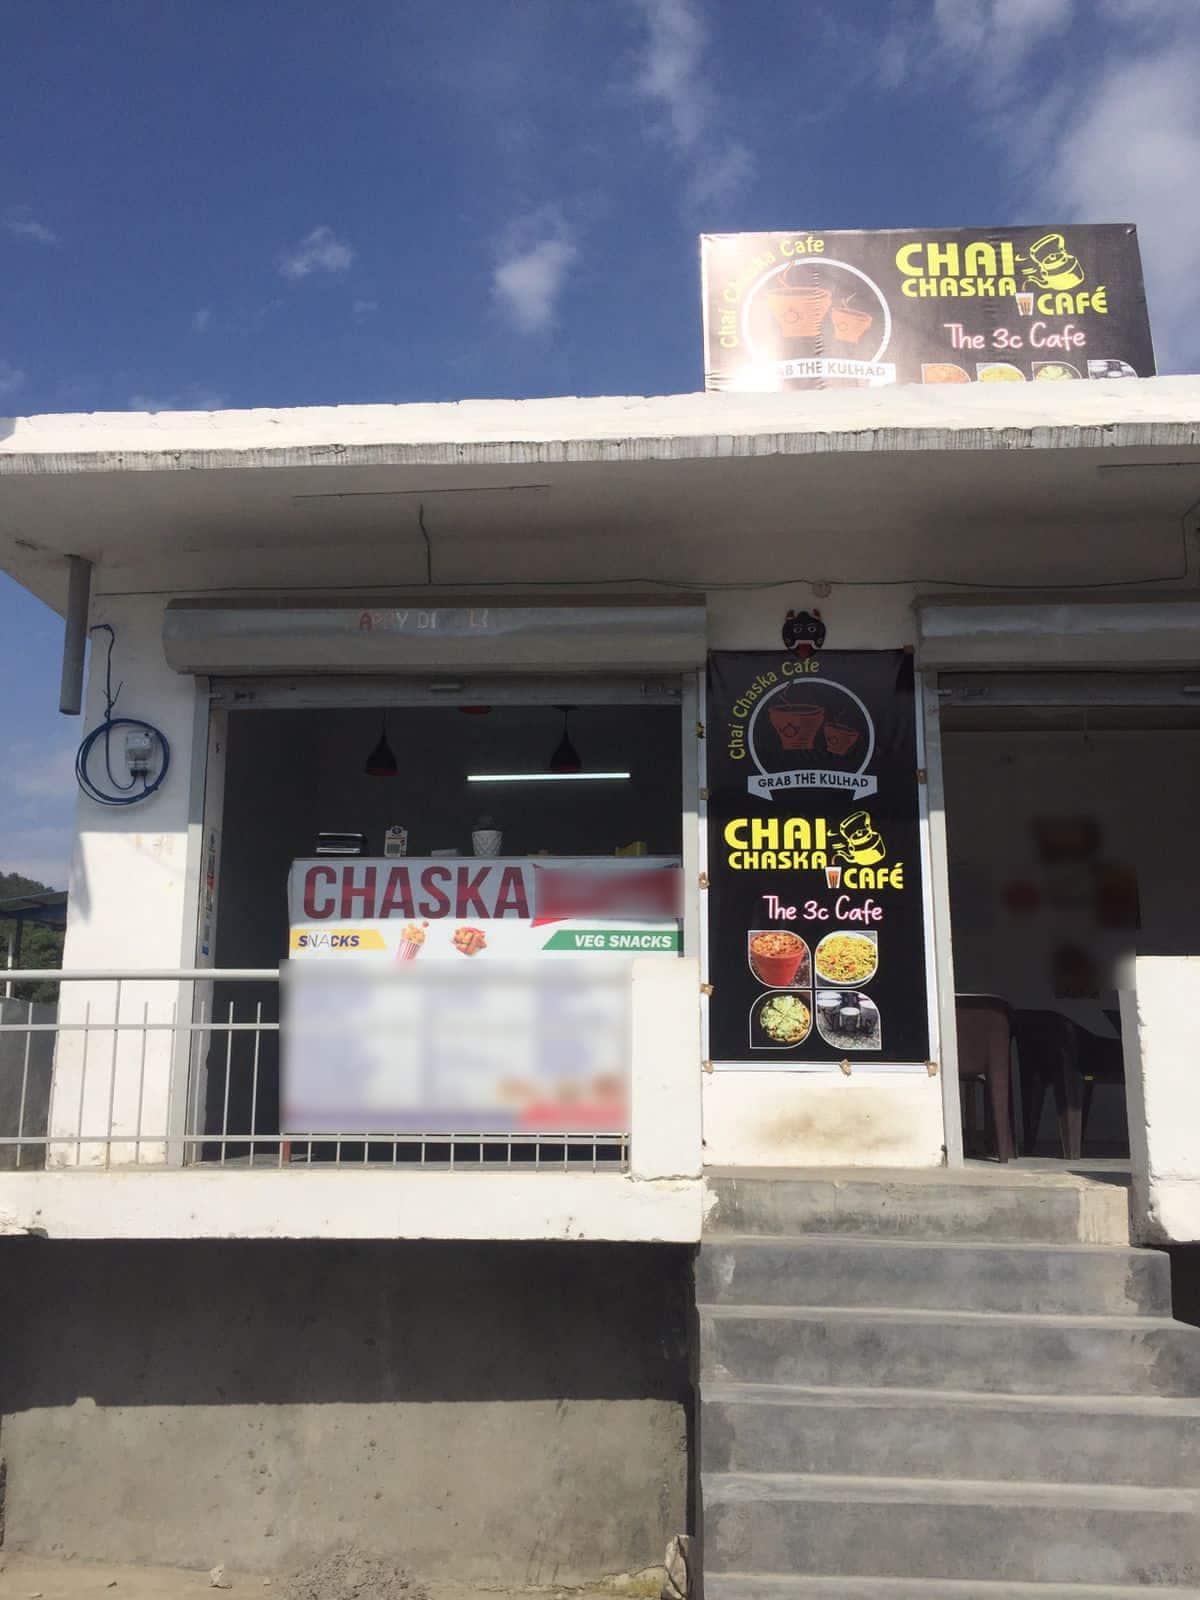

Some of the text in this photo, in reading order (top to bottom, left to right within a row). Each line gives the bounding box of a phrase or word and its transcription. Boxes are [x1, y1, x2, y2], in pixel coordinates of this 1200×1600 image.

[779, 236, 825, 257] Cafe
[895, 241, 1015, 276] CHAI
[901, 277, 1017, 298] CHASKA
[1037, 285, 1108, 316] CAFÉ
[944, 321, 1087, 352] The 3c Cafe
[798, 361, 822, 375] THE
[827, 361, 887, 377] KULHAD
[727, 657, 821, 760] Chai Chaska Cafe
[758, 772, 869, 788] GRAB THE KULHAD
[723, 817, 828, 850] CHAI
[728, 851, 827, 870] CHASKA
[843, 862, 904, 889] CAFÉ
[303, 865, 531, 920] CHASKA
[762, 894, 883, 925] The 3c Cafe
[297, 933, 361, 948] SNACKS
[575, 934, 673, 948] VEG SNACKS
